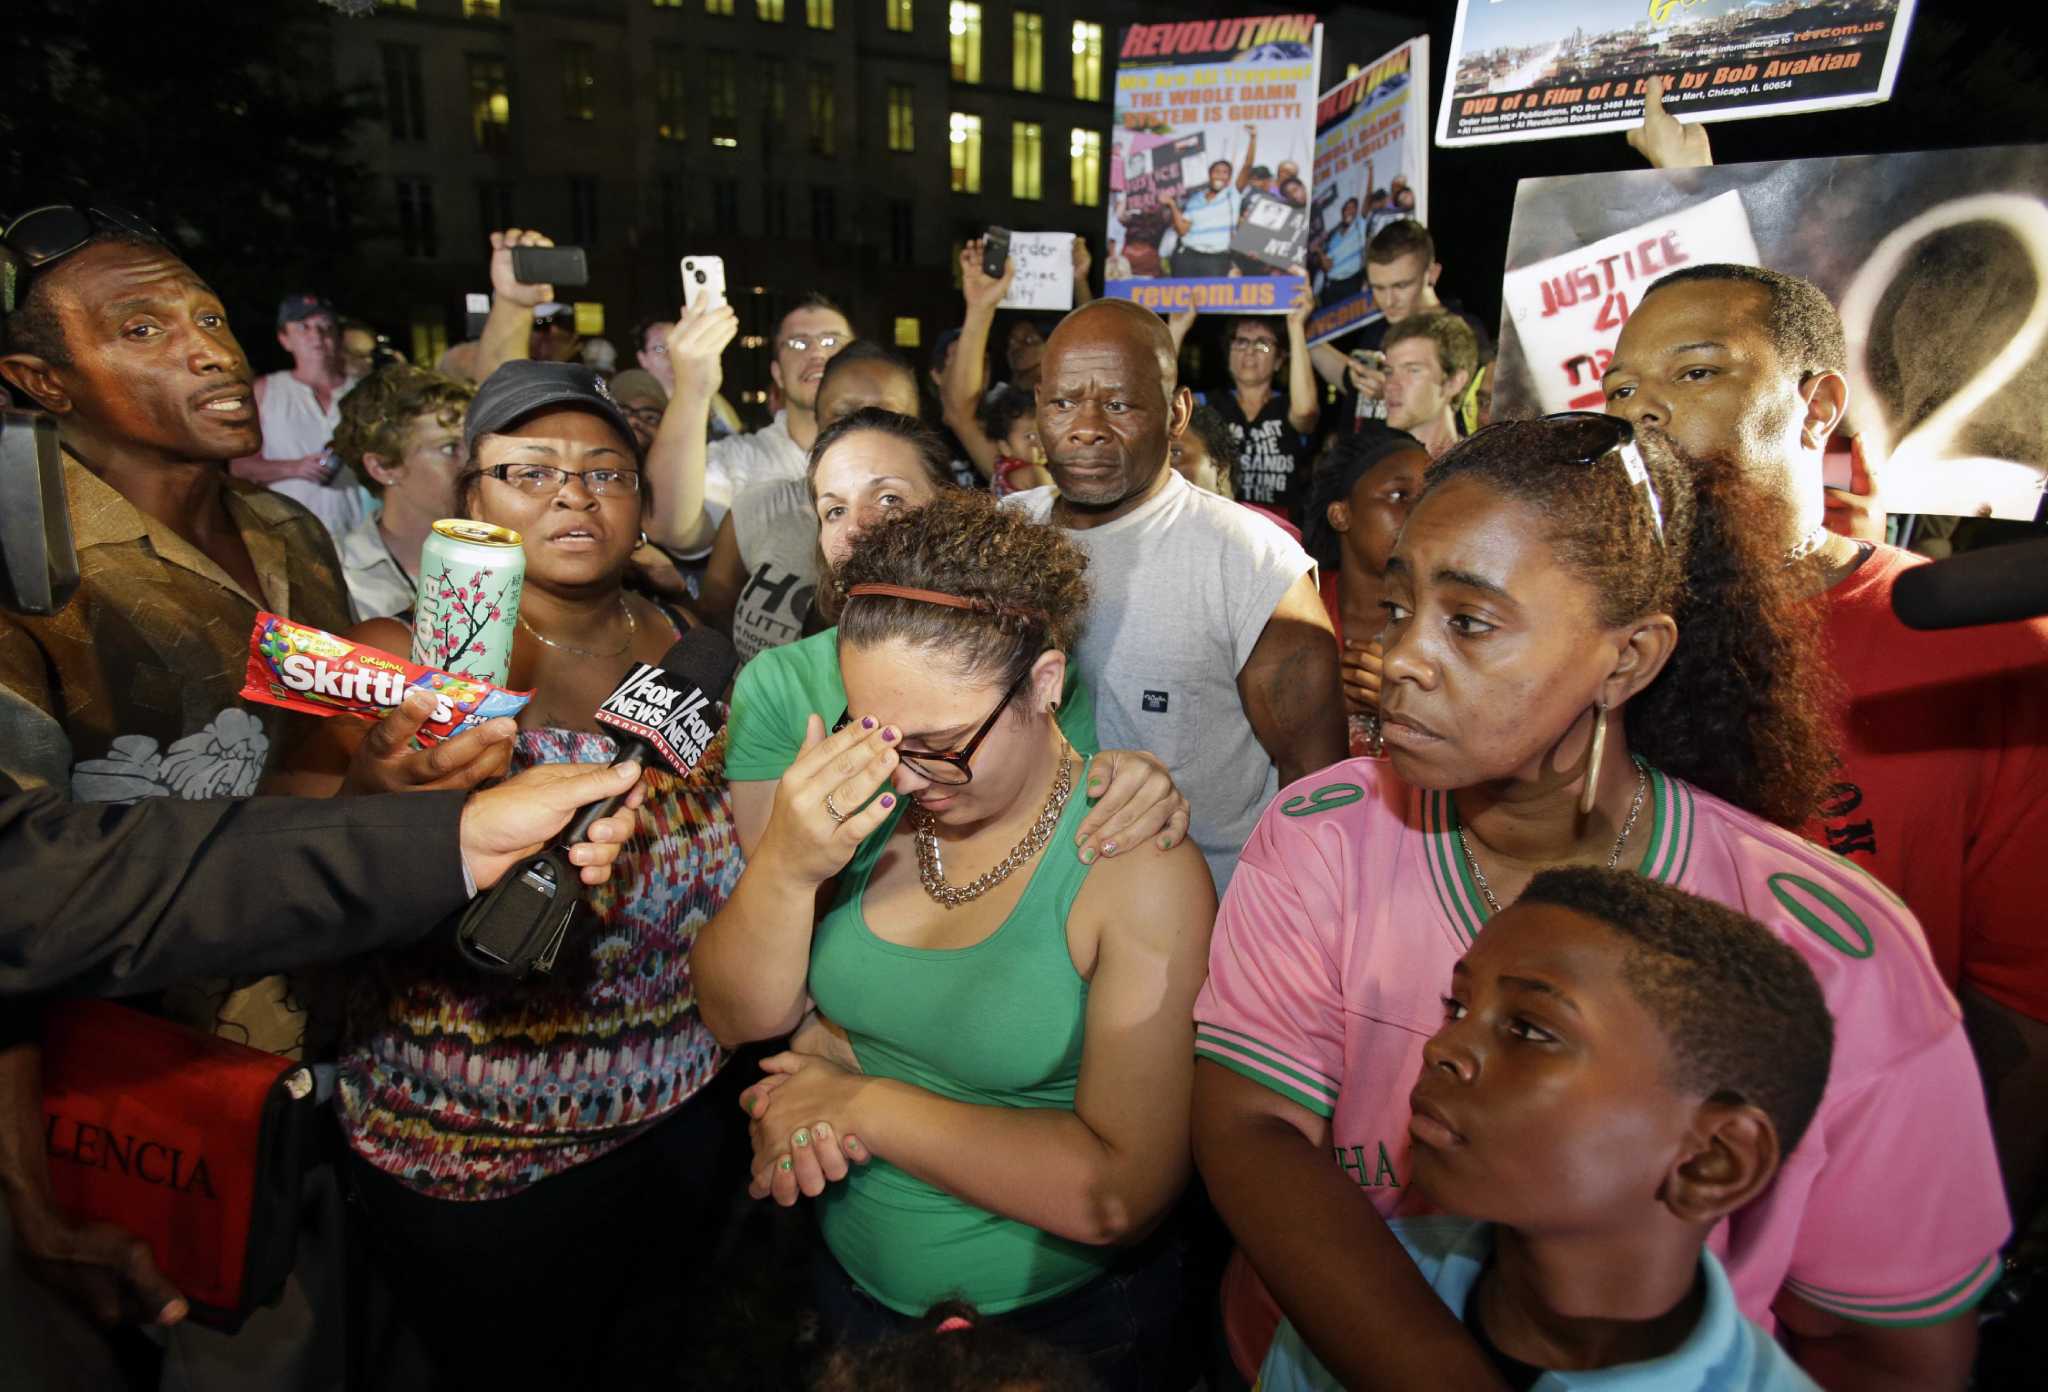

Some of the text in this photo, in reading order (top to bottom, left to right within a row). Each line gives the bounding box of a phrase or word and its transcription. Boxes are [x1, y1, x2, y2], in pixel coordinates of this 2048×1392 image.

[1120, 14, 1316, 58] REVOLUTION
[1793, 20, 1885, 43] revcom.us
[1130, 84, 1297, 108] THE WHOLE DAMN
[1461, 96, 1498, 116] DVD
[1501, 94, 1523, 111] of
[1525, 94, 1539, 108] a
[1543, 87, 1583, 106] Film
[1587, 81, 1612, 100] of
[1614, 82, 1629, 97] a
[1680, 71, 1710, 90] by
[1712, 64, 1759, 85] Bob
[1762, 51, 1862, 79] Avakian
[1707, 83, 1748, 98] Chicago,
[1750, 82, 1760, 92] IL
[1762, 80, 1792, 92] 60654
[1540, 229, 1689, 318] JUSTICE
[610, 695, 667, 727] NEWS
[633, 680, 682, 710] FOX
[594, 712, 653, 738] channel
[664, 719, 701, 768] NEWS
[683, 709, 715, 751] FOX
[651, 734, 690, 779] channel
[45, 1113, 217, 1200] LENCIA
